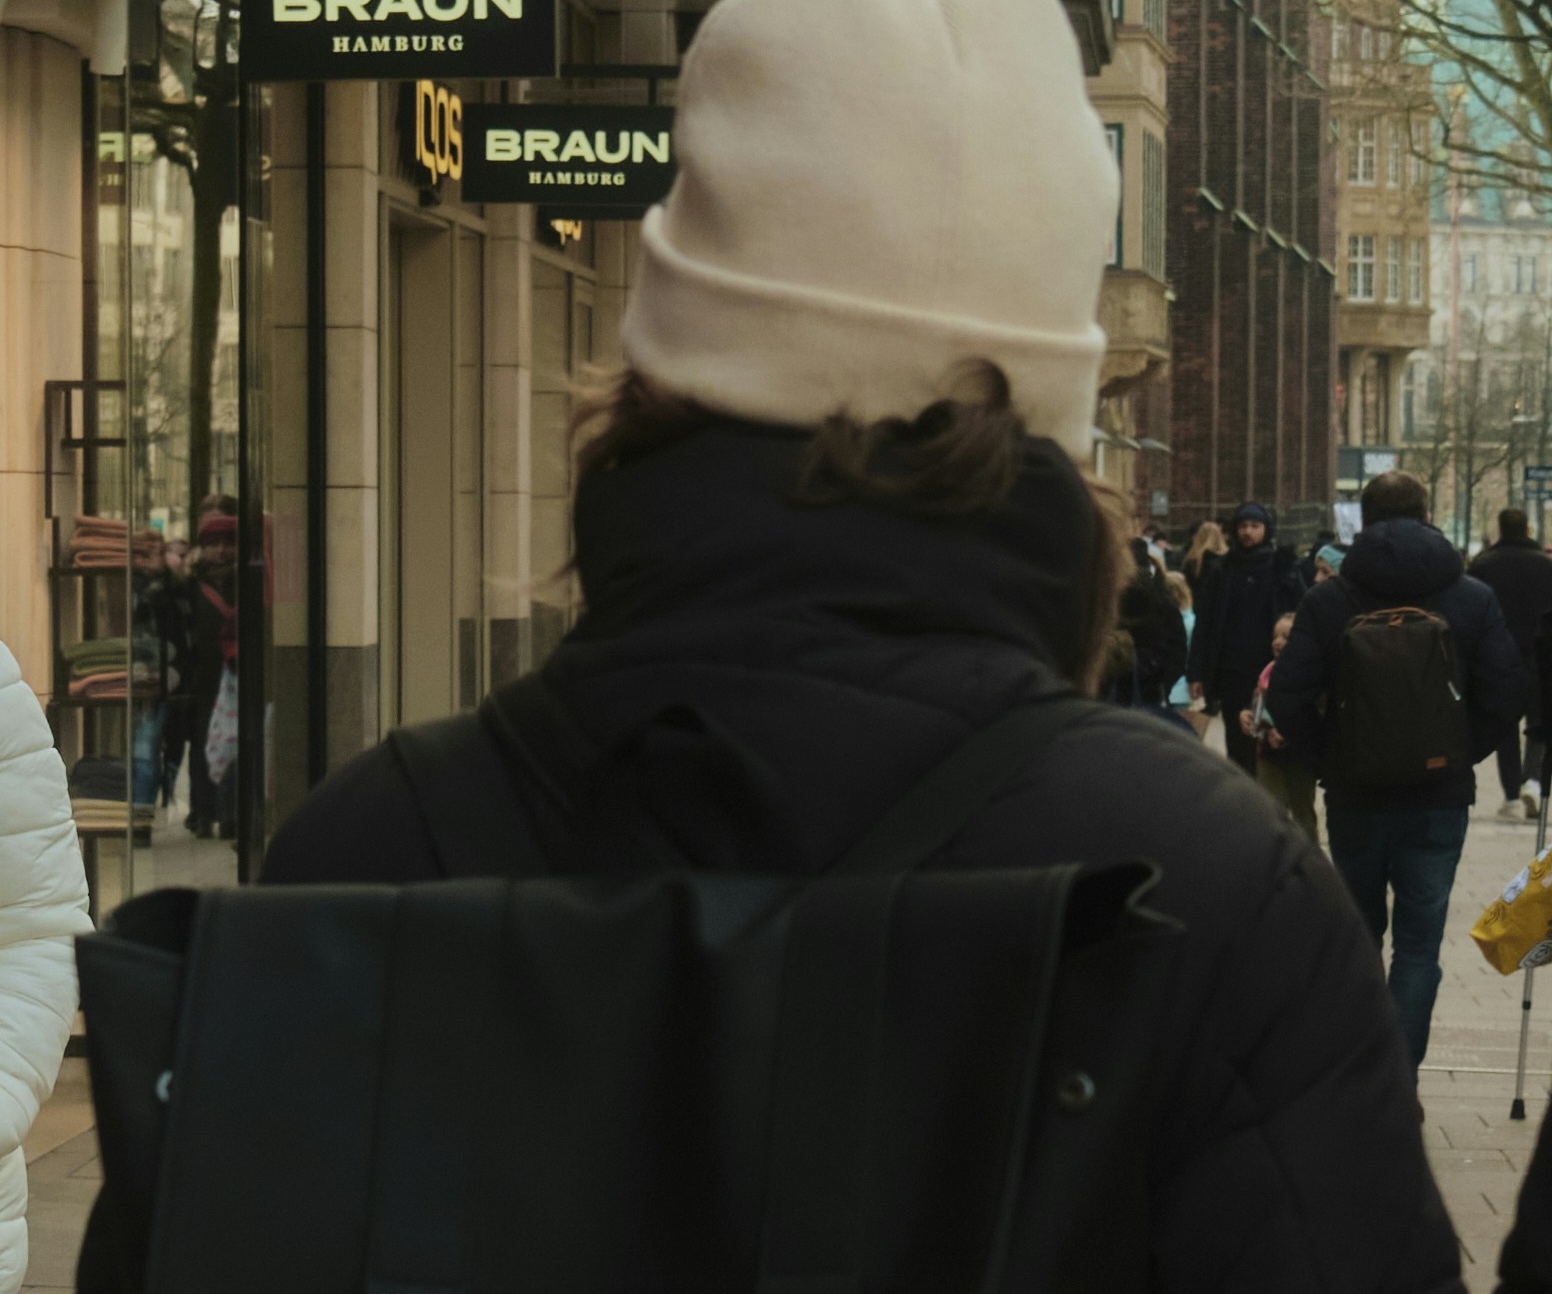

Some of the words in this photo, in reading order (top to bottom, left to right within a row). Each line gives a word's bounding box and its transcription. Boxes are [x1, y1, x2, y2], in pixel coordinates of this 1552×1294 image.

[332, 35, 464, 52] HAMBURG
[416, 79, 462, 185] IQOS
[486, 129, 669, 163] BRAUN
[529, 171, 626, 186] HAMBURG
